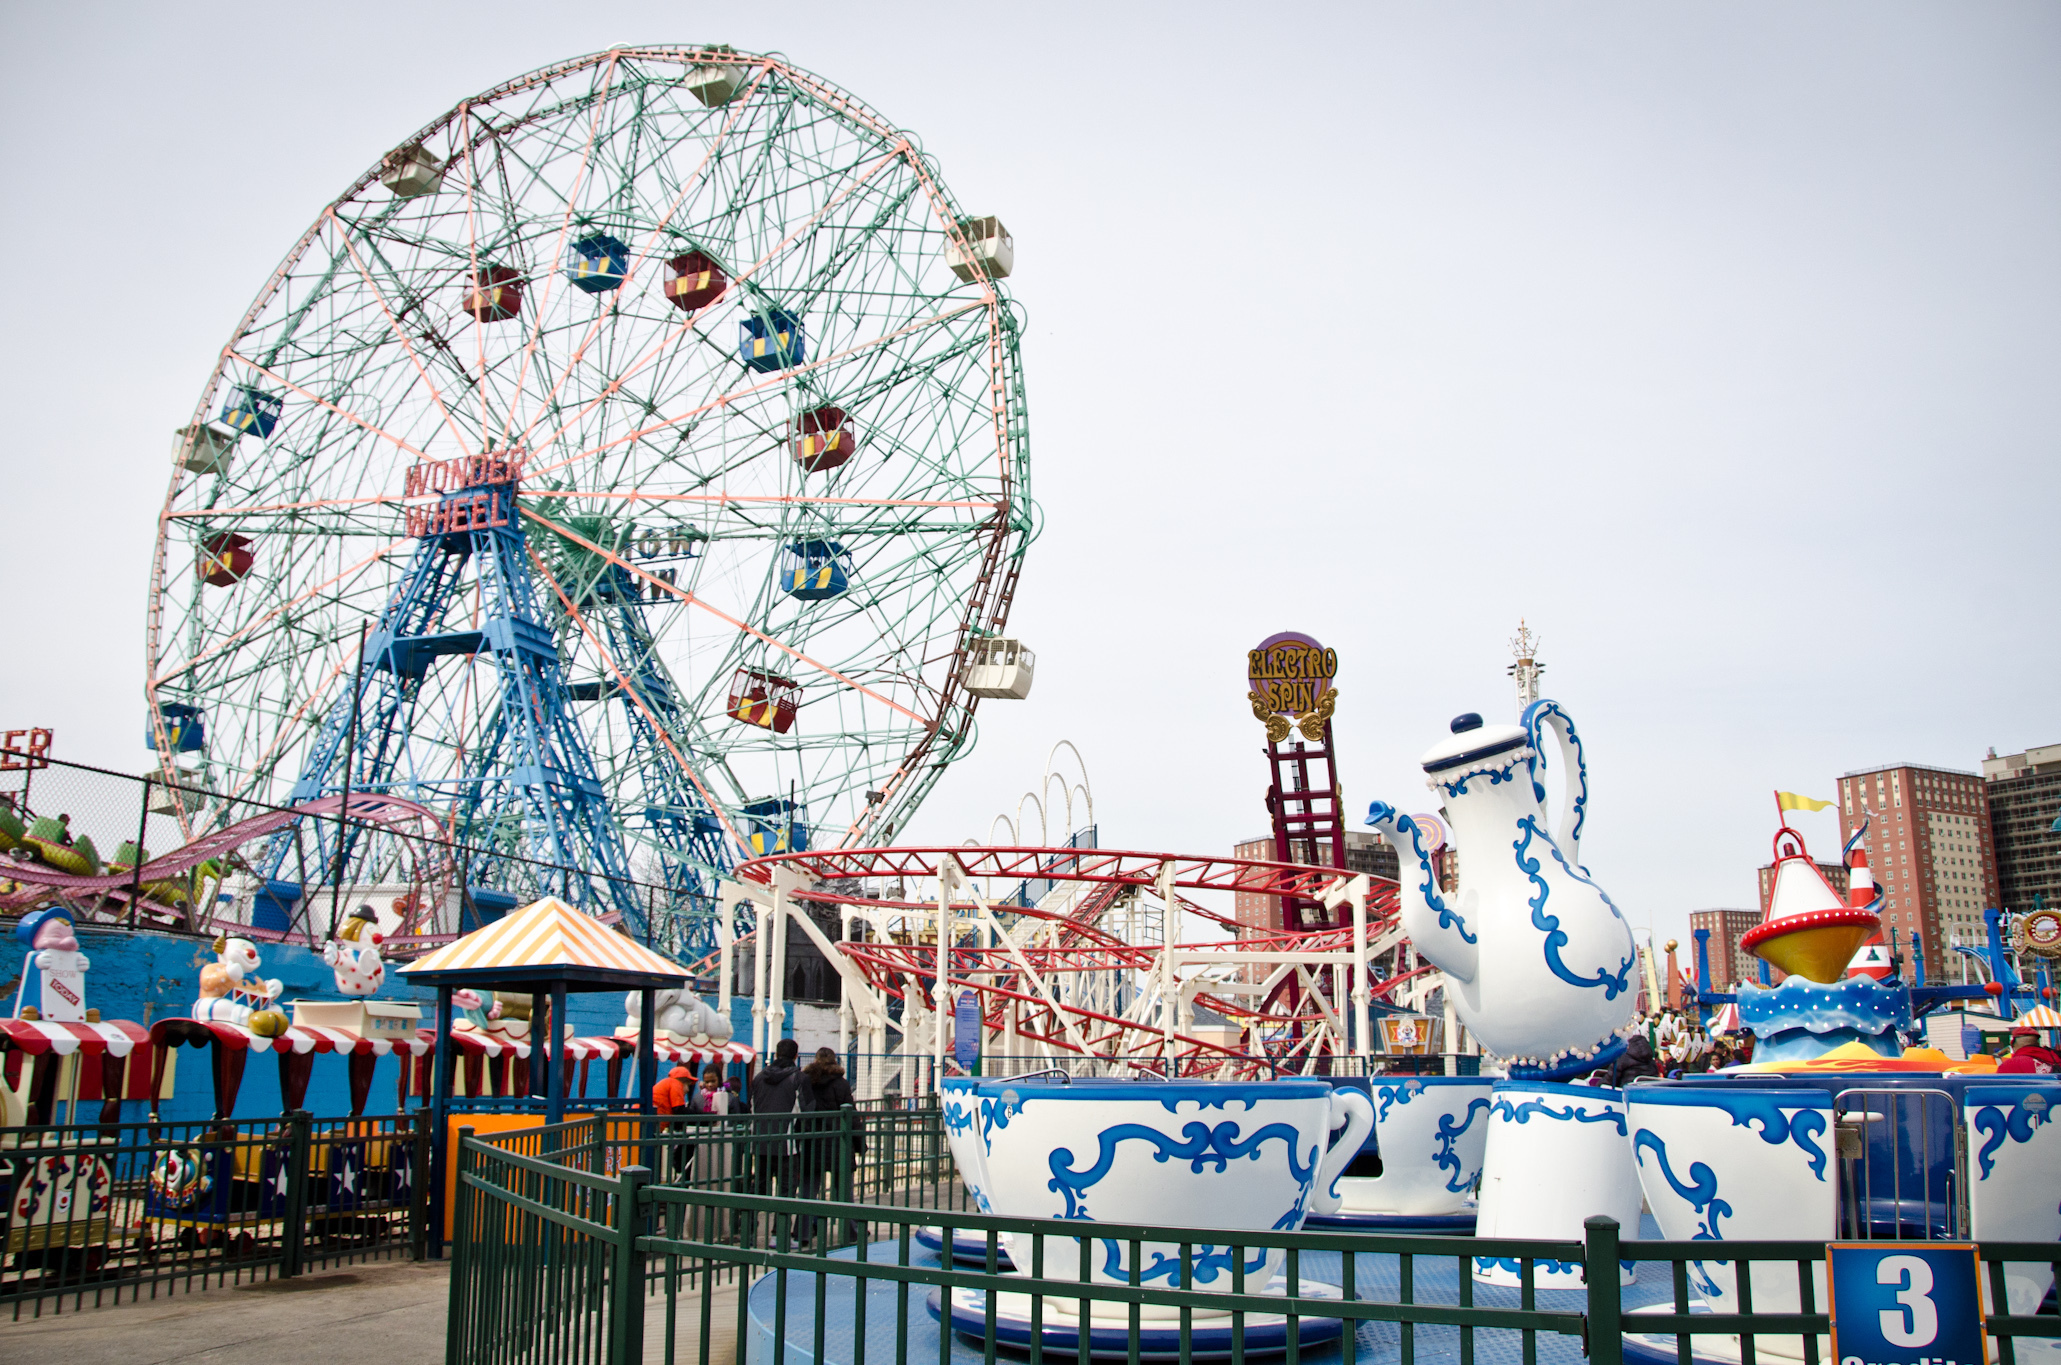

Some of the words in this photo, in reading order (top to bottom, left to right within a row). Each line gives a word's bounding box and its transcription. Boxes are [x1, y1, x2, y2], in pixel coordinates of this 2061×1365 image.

[405, 447, 527, 498] WONDER
[404, 492, 509, 538] WHEEL
[1247, 647, 1338, 679] ELECTRO
[1267, 682, 1315, 713] SPIN
[50, 970, 77, 978] SHOW
[51, 979, 80, 1006] TODAY
[1007, 1106, 1013, 1119] 6
[2033, 1114, 2038, 1130] 1
[1876, 1255, 1938, 1348] 3
